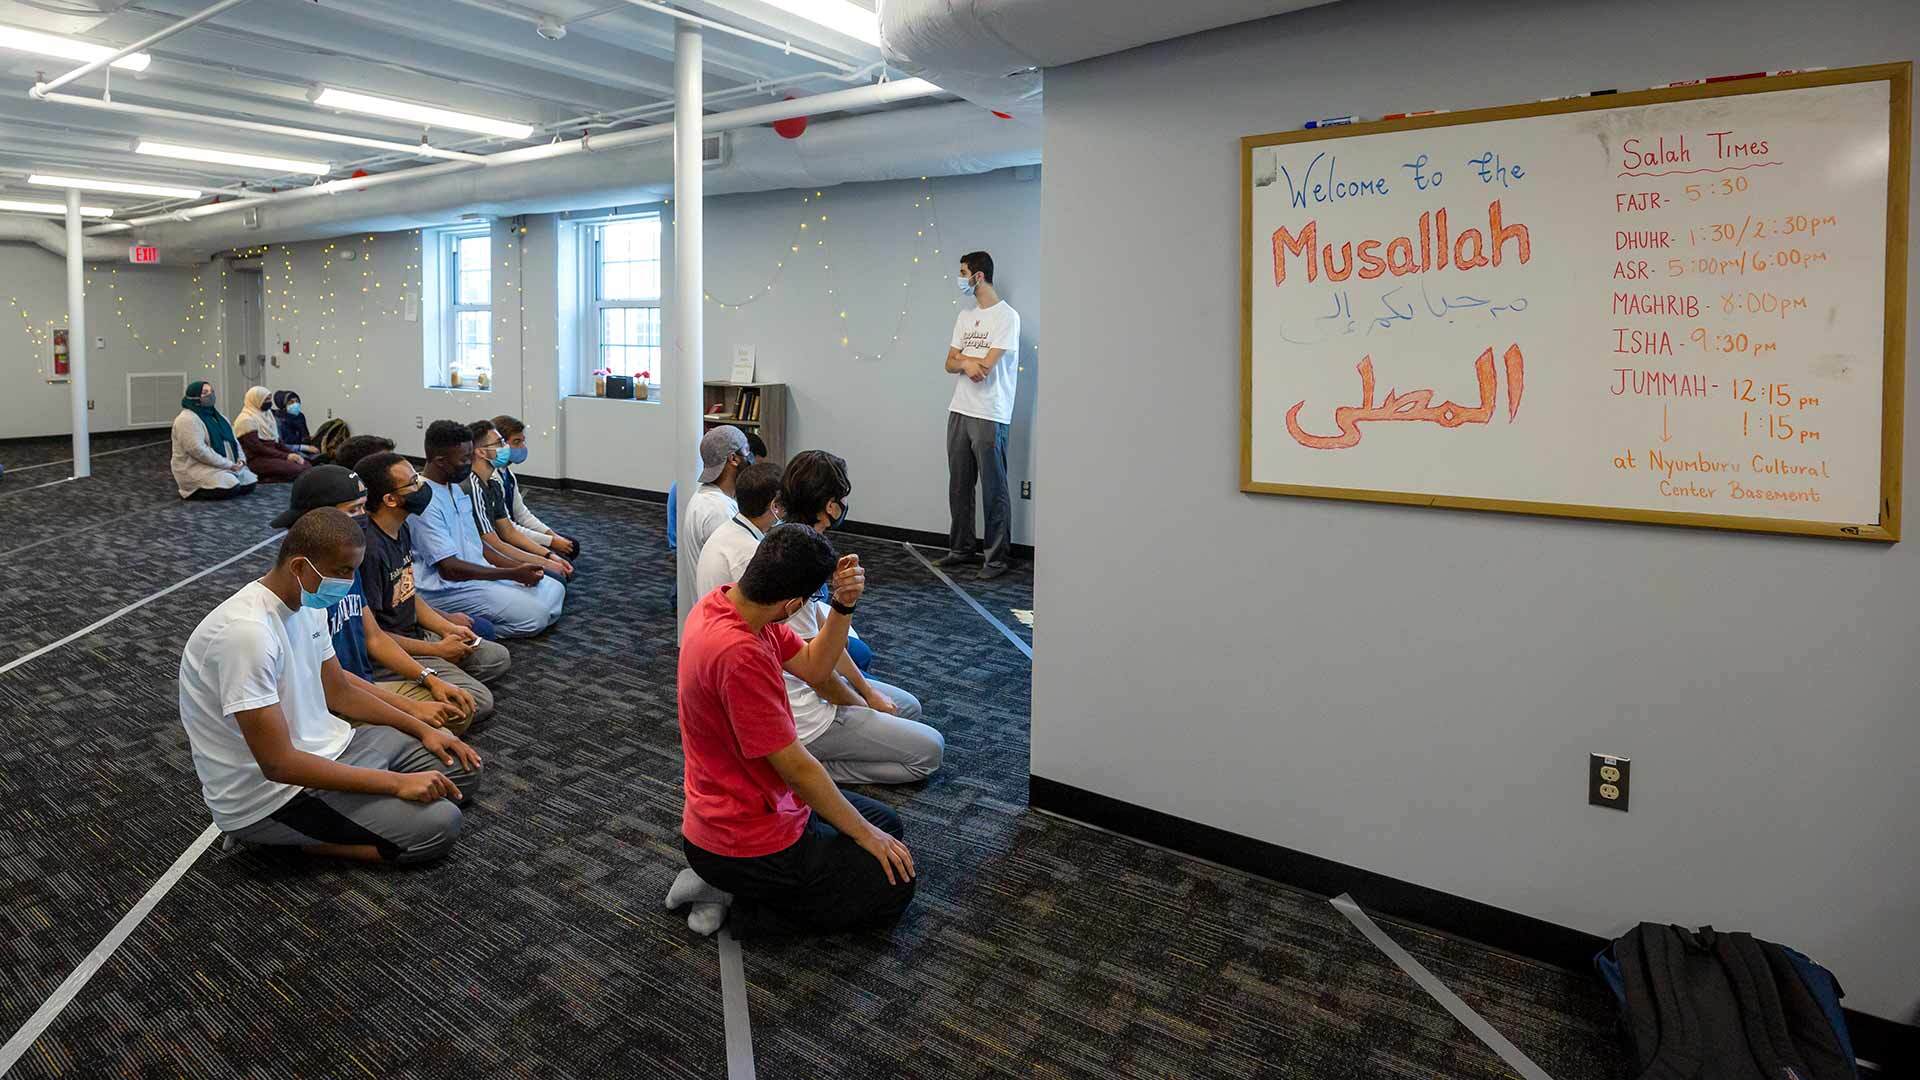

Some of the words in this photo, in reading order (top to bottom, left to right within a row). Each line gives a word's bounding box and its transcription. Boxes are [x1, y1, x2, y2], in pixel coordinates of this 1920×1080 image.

[1622, 134, 1691, 170] Salah
[1280, 151, 1390, 209] Welcome
[1402, 153, 1443, 190] to
[1467, 151, 1526, 188] the
[1685, 175, 1749, 201] 5:30
[136, 247, 157, 262] EXIT
[1271, 199, 1531, 288] Musallah
[1285, 342, 1525, 450] المصلى
[1732, 378, 1792, 407] 12:15
[1613, 449, 1637, 470] at
[1649, 449, 1741, 480] Nyumburu
[1751, 454, 1831, 479] Cultural
[1658, 480, 1717, 499] Center
[1728, 480, 1822, 503] Basement
